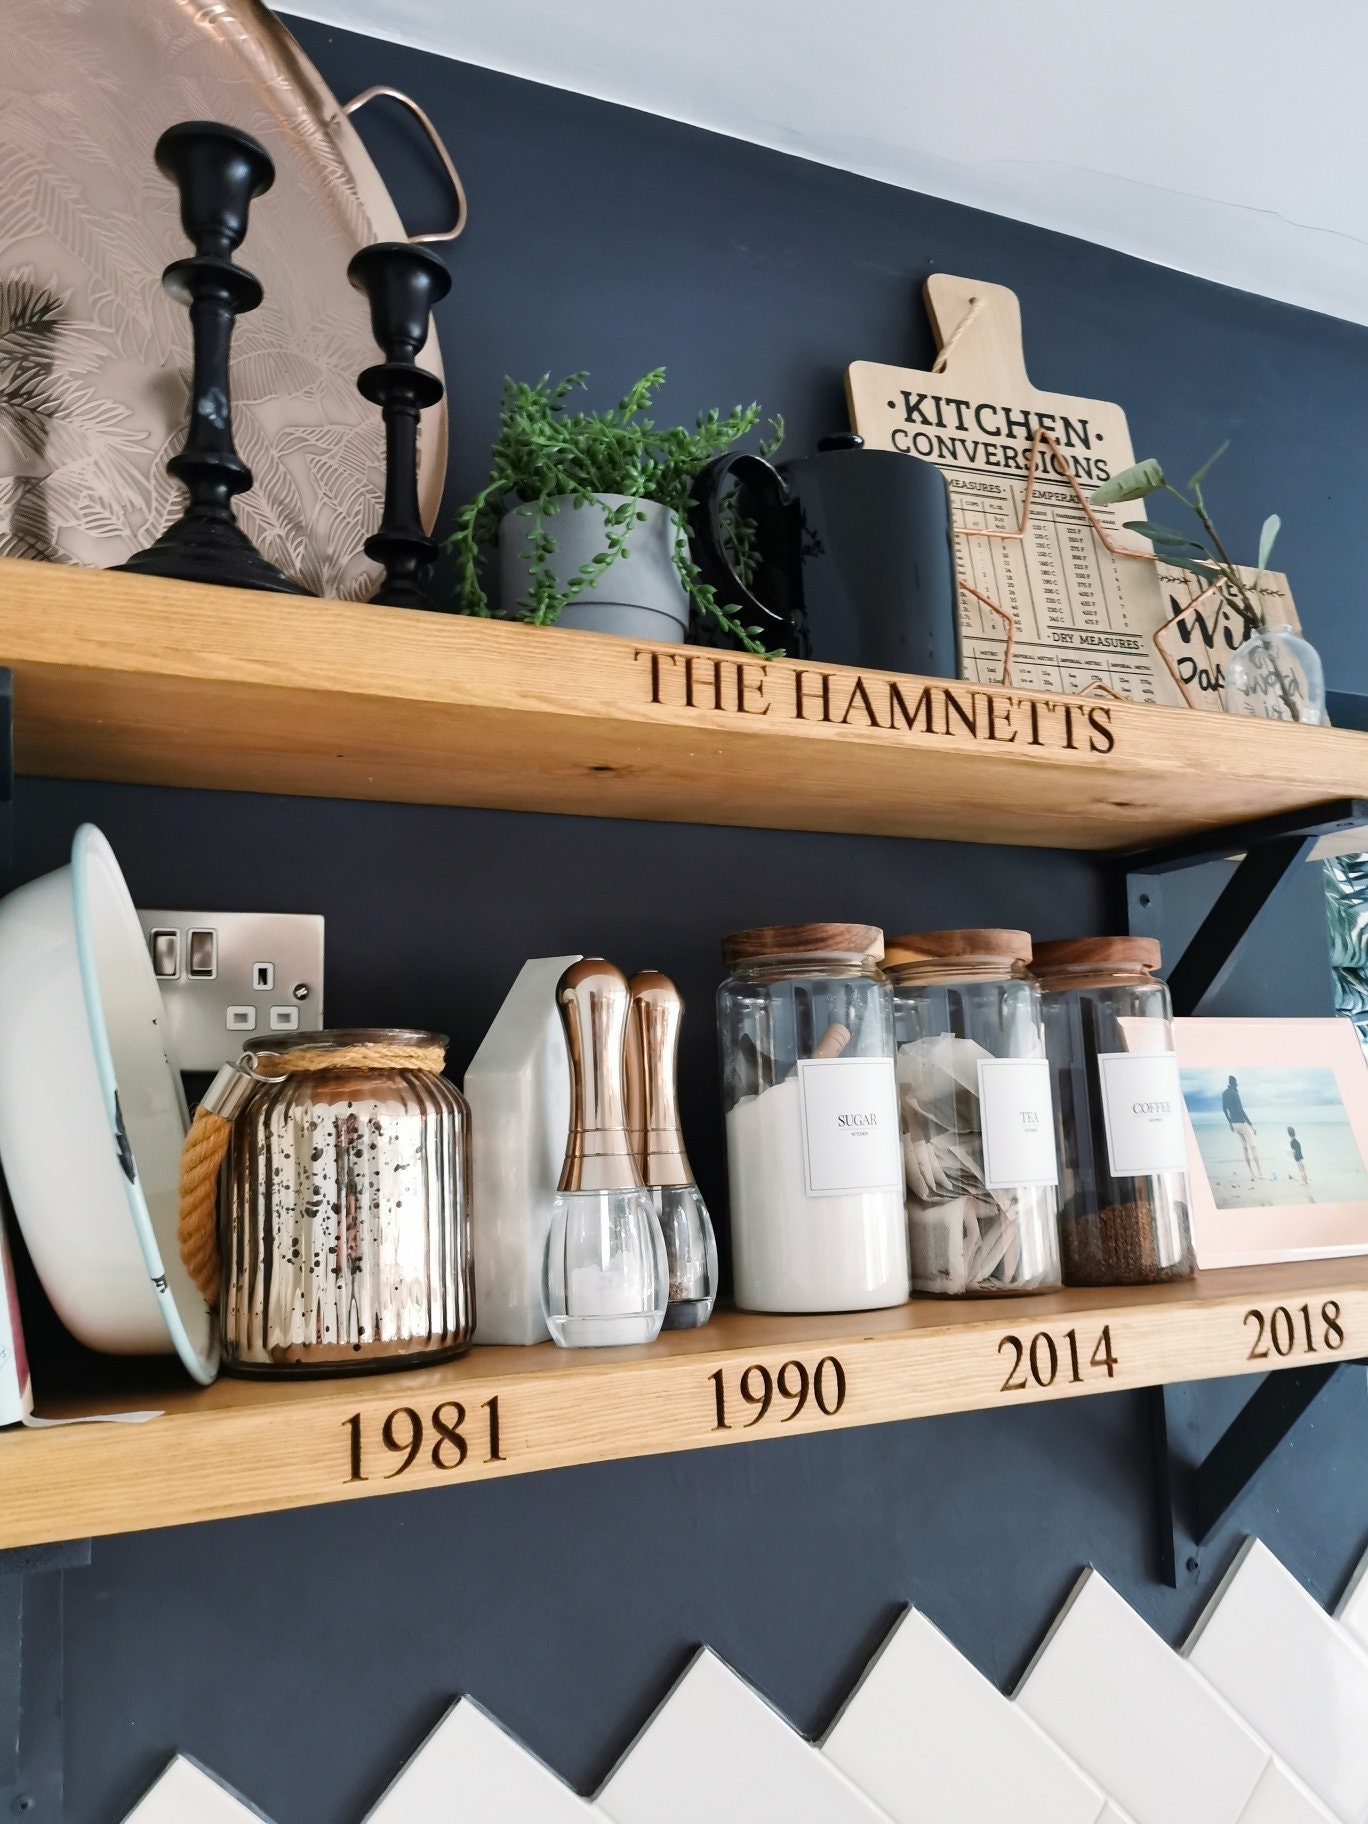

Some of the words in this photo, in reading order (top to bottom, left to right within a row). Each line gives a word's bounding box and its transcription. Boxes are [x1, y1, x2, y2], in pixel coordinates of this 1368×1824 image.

[900, 390, 1092, 450] KITCHEN
[891, 428, 1111, 482] CONVERSIONS
[1052, 632, 1074, 644] DRY
[1080, 635, 1141, 650] MEASURES
[634, 651, 772, 716] THE
[792, 669, 1115, 754] HAMNETTS
[838, 1113, 878, 1127] SUGAR
[1020, 1111, 1040, 1123] TEA
[998, 1324, 1119, 1392] 2014
[1243, 1300, 1345, 1361] 2018
[707, 1355, 847, 1431] 1990
[341, 1395, 507, 1485] 1981
